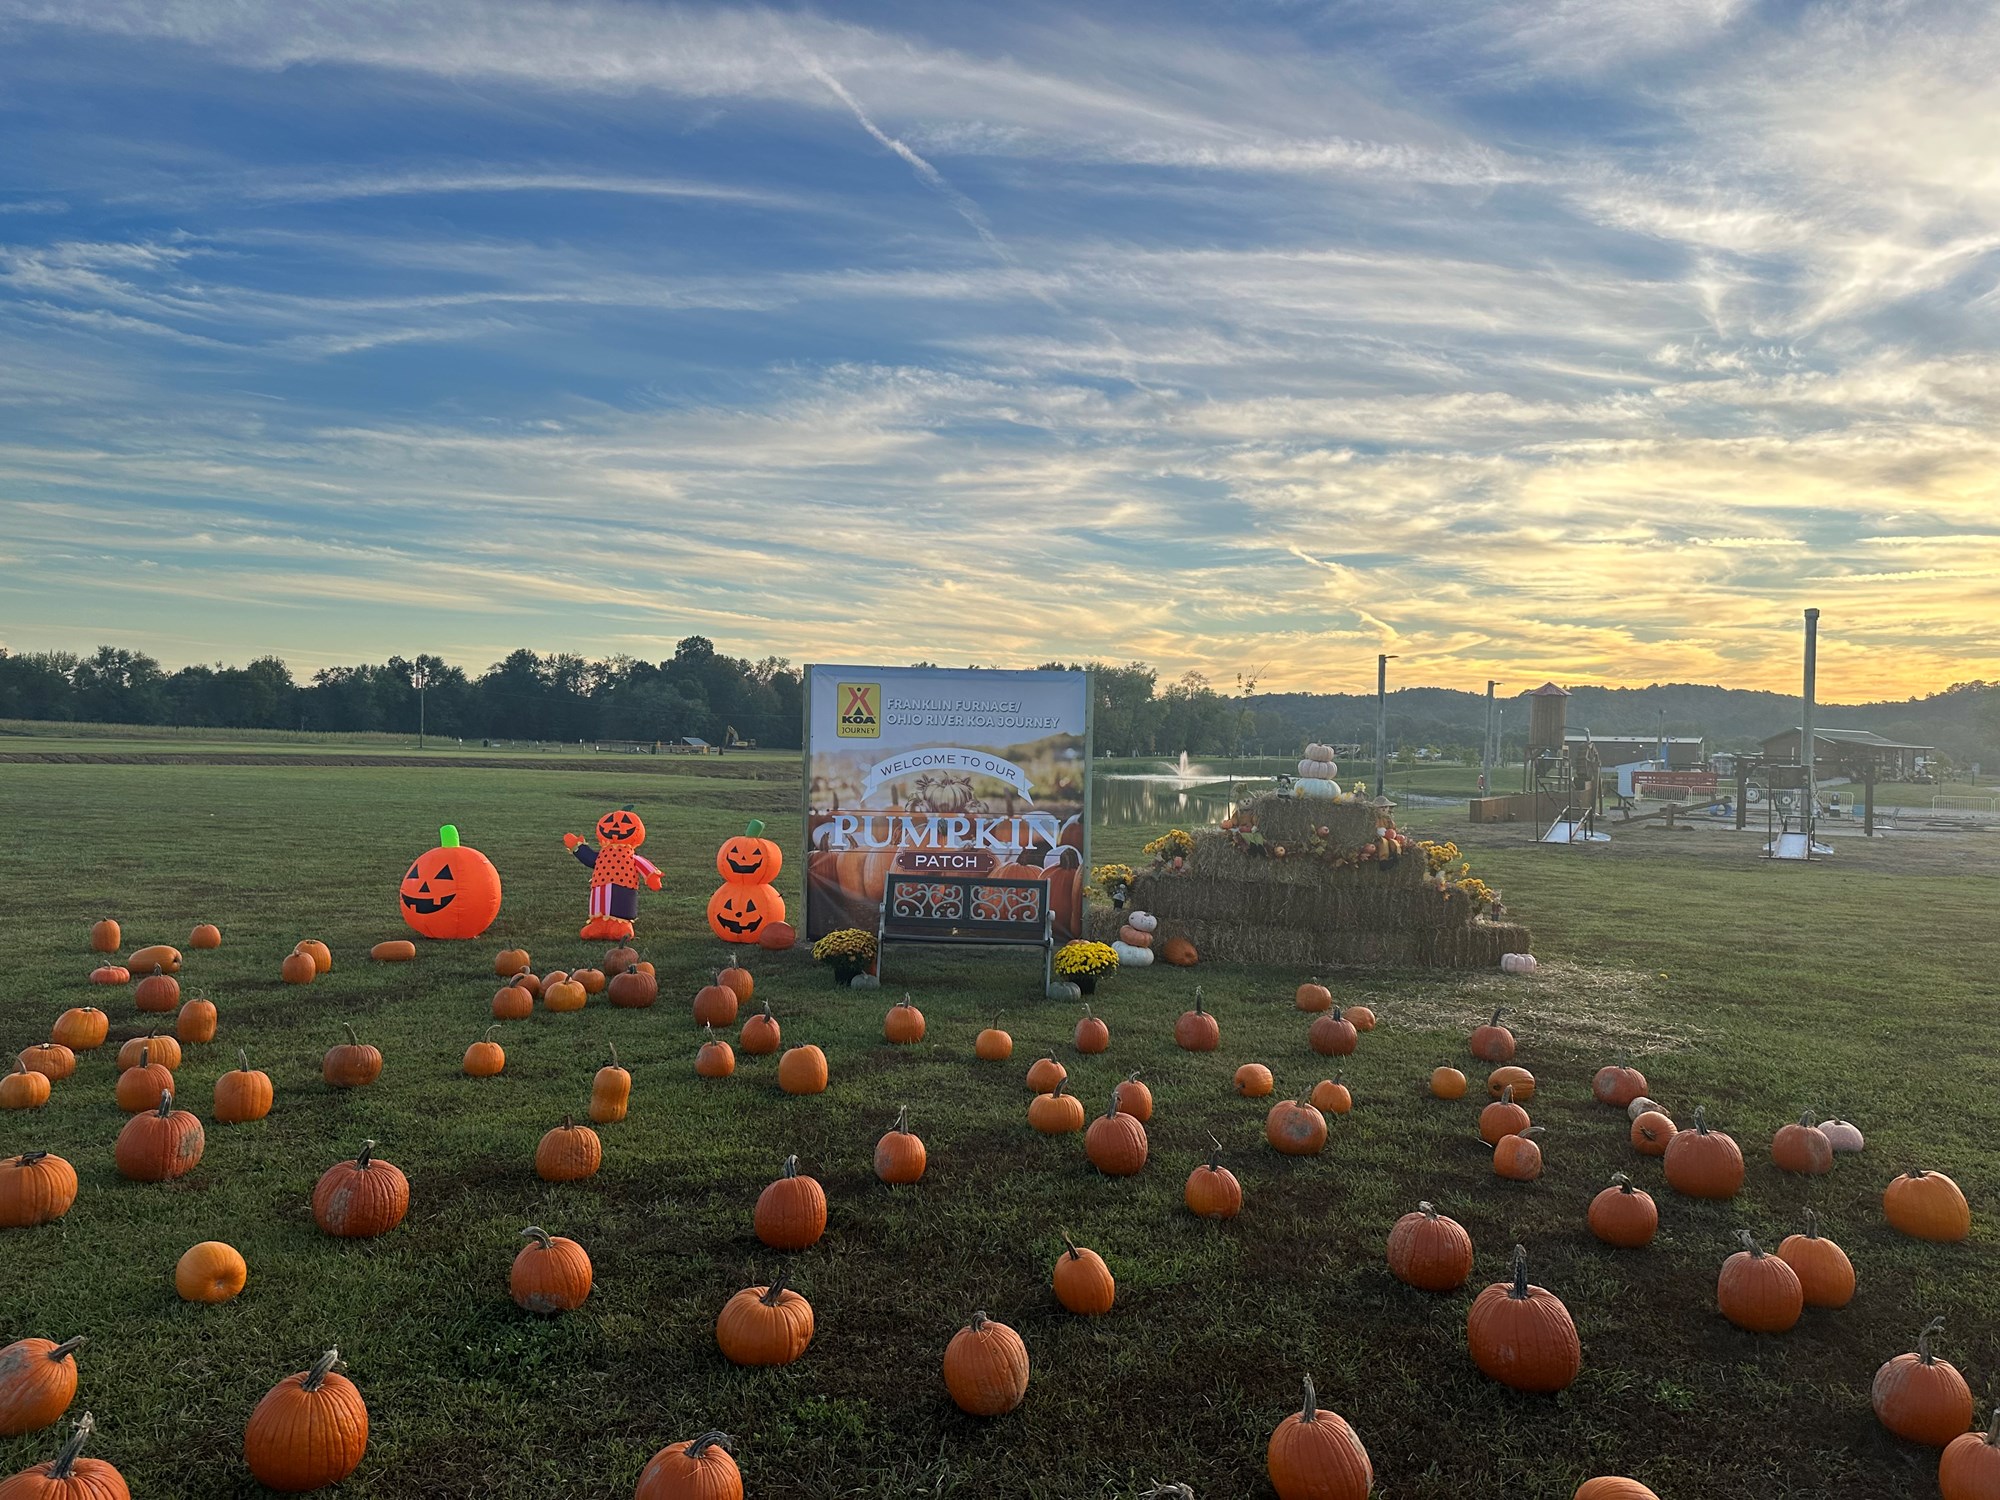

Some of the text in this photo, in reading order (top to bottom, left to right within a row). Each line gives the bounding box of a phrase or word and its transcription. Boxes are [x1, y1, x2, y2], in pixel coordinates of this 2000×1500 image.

[887, 698, 1022, 713] FRANKLIN FURNACE/
[842, 716, 876, 724] KOA
[886, 714, 1060, 728] OHIO RIVER KOA JOURNEY
[880, 754, 1016, 780] WELCOME TO OUR
[832, 815, 1061, 850] PUMPKIN
[915, 854, 977, 868] PATCH
